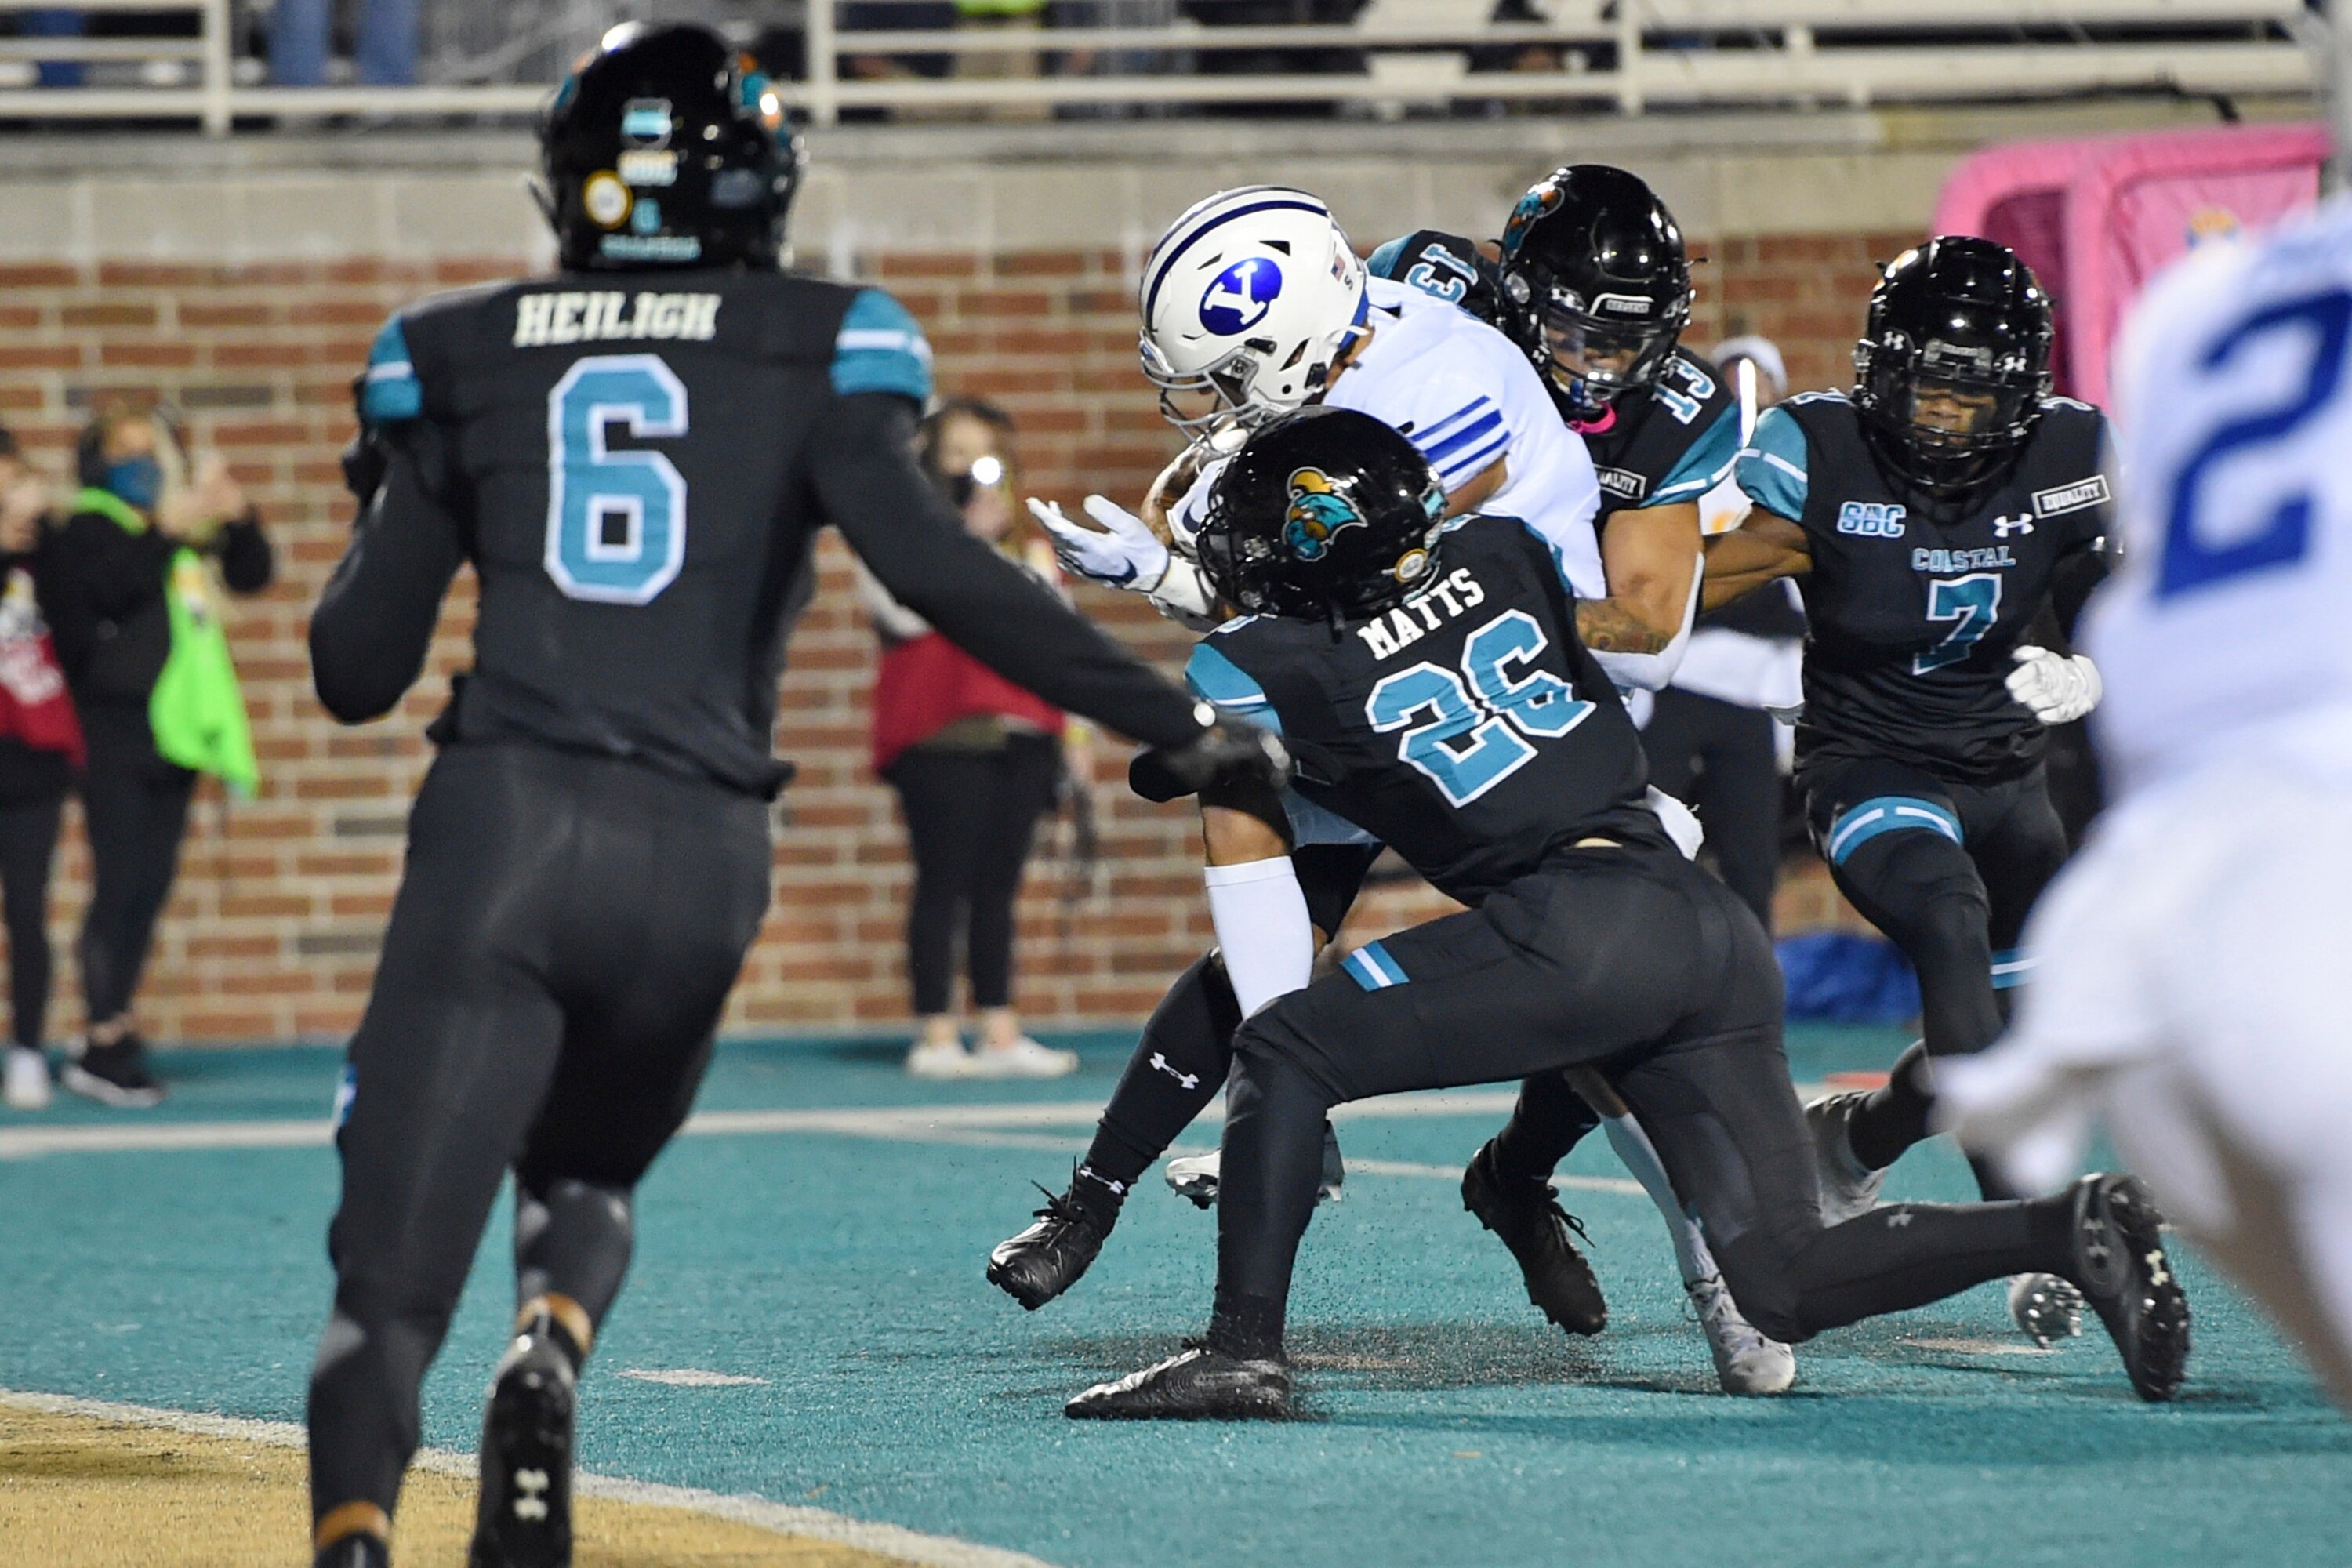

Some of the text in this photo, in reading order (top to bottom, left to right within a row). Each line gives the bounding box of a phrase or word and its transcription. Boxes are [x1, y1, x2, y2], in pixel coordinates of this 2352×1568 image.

[512, 292, 722, 348] HEILIGH
[1403, 242, 1479, 305] 13
[1650, 355, 1716, 425] 13
[544, 353, 689, 605] 6
[2158, 285, 2352, 604] 2
[1837, 500, 1907, 539] SBC
[1357, 568, 1485, 661] MATTS
[1912, 573, 2002, 676] 7
[1365, 608, 1597, 809] 26
